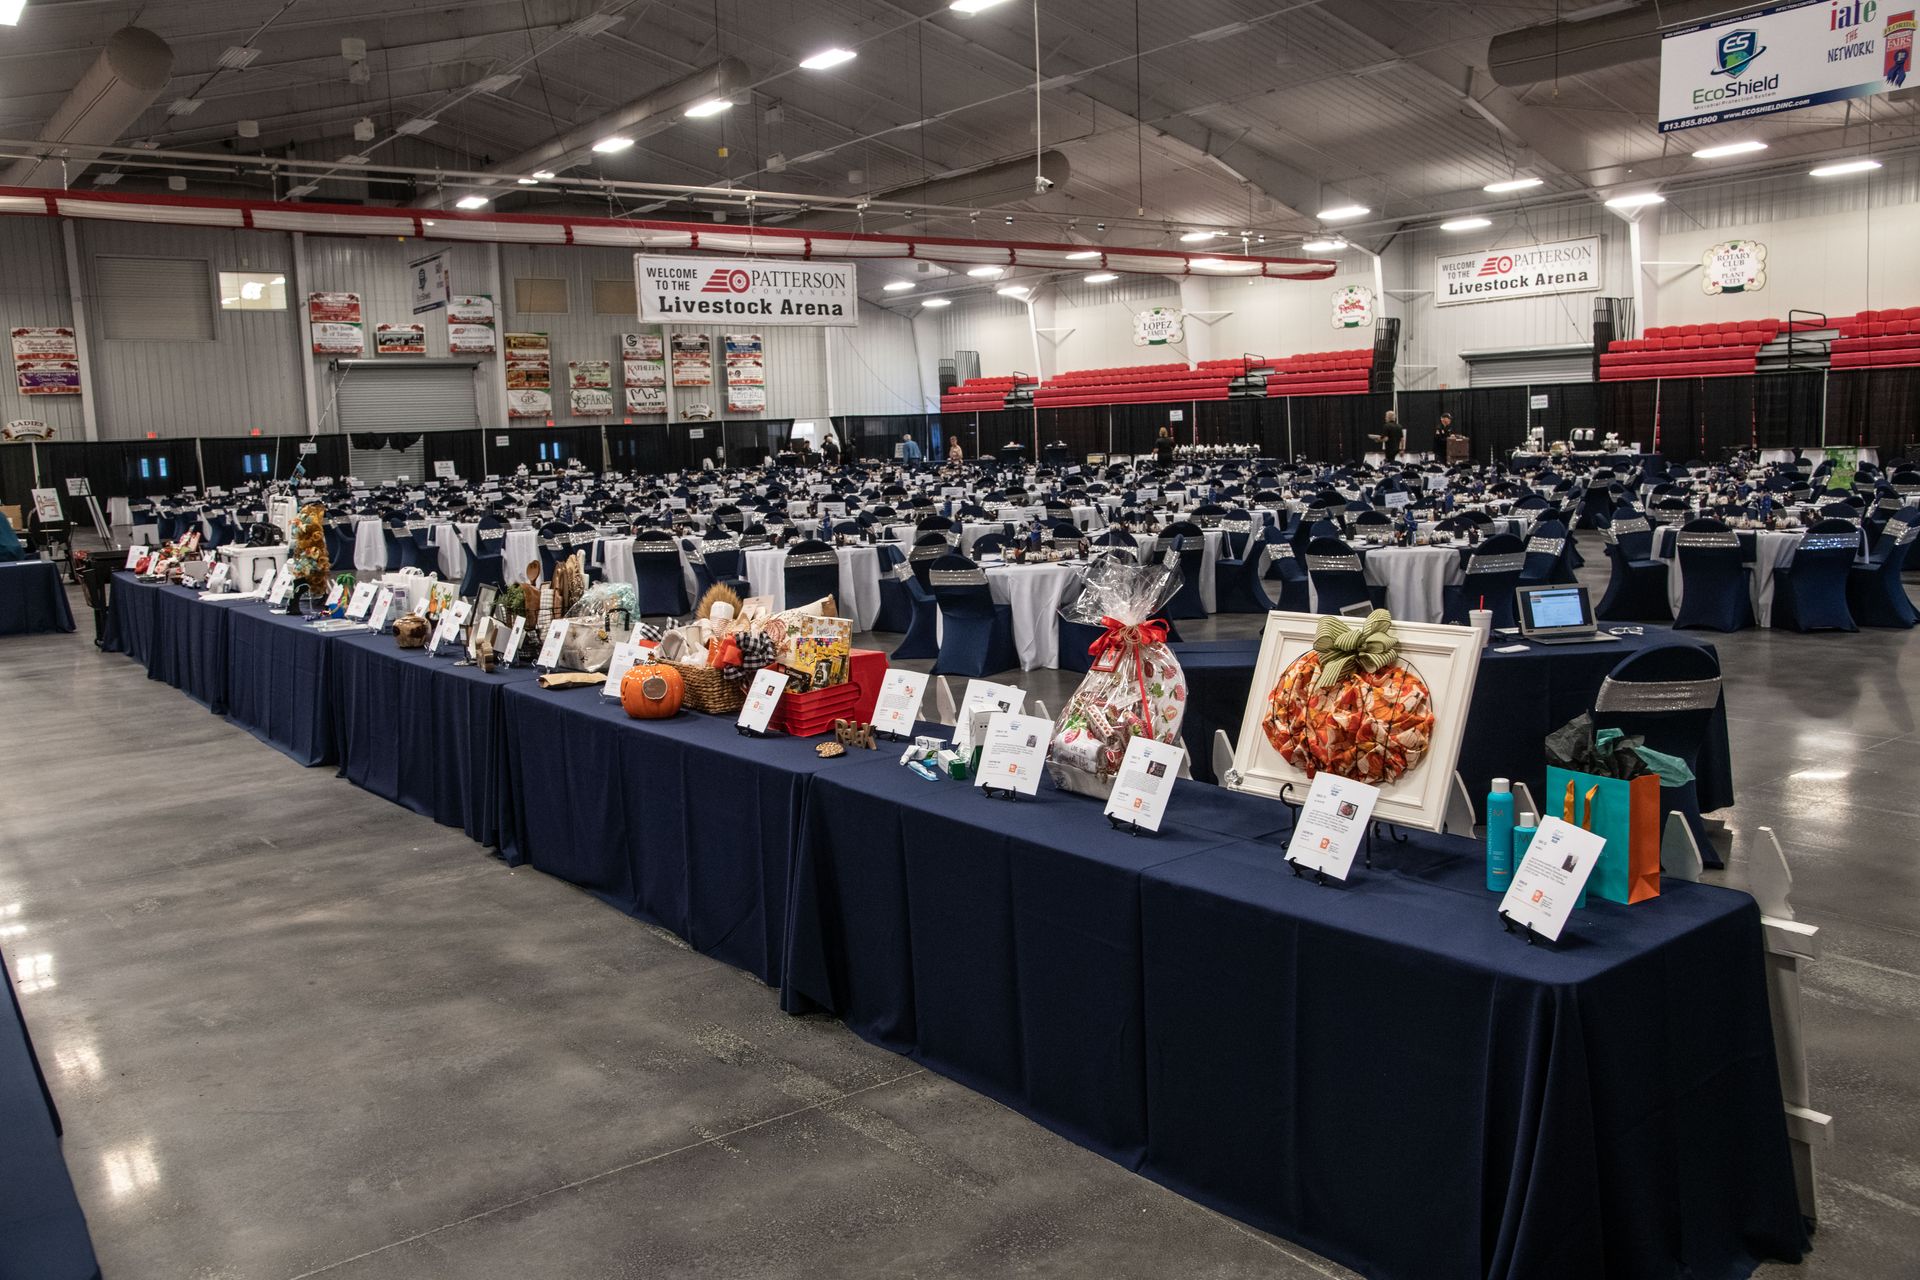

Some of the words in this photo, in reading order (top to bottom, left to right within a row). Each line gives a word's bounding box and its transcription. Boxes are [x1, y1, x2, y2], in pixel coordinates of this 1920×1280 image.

[1845, 28, 1858, 44] THE
[1723, 33, 1752, 53] ES
[1887, 37, 1912, 48] FAIRS
[1828, 40, 1875, 63] NETWORK!
[1693, 74, 1779, 104] EcoShield
[1721, 96, 1754, 105] Protection
[1754, 91, 1777, 100] System
[1663, 115, 1718, 131] 813.855.8900
[1723, 99, 1811, 119] www.ECOSHIELDINC.com
[1514, 245, 1592, 267] PATTERSON
[1717, 252, 1750, 262] ROTARY
[1442, 261, 1476, 272] WELCOME
[646, 267, 698, 279] WELCOME
[1447, 272, 1457, 280] TO
[1458, 271, 1470, 279] THE
[656, 280, 669, 290] TO
[671, 280, 690, 290] THE
[752, 270, 846, 289] PATTERSON
[1449, 275, 1529, 296] Livestock
[1535, 271, 1589, 287] Arena
[752, 288, 846, 297] COMPANIES
[659, 296, 772, 315] Livestock
[780, 299, 844, 316] Arena
[1143, 320, 1173, 331] LOPEZ
[627, 364, 661, 376] KATHLEEN
[587, 394, 613, 405] FARMS
[10, 420, 44, 428] LADIES
